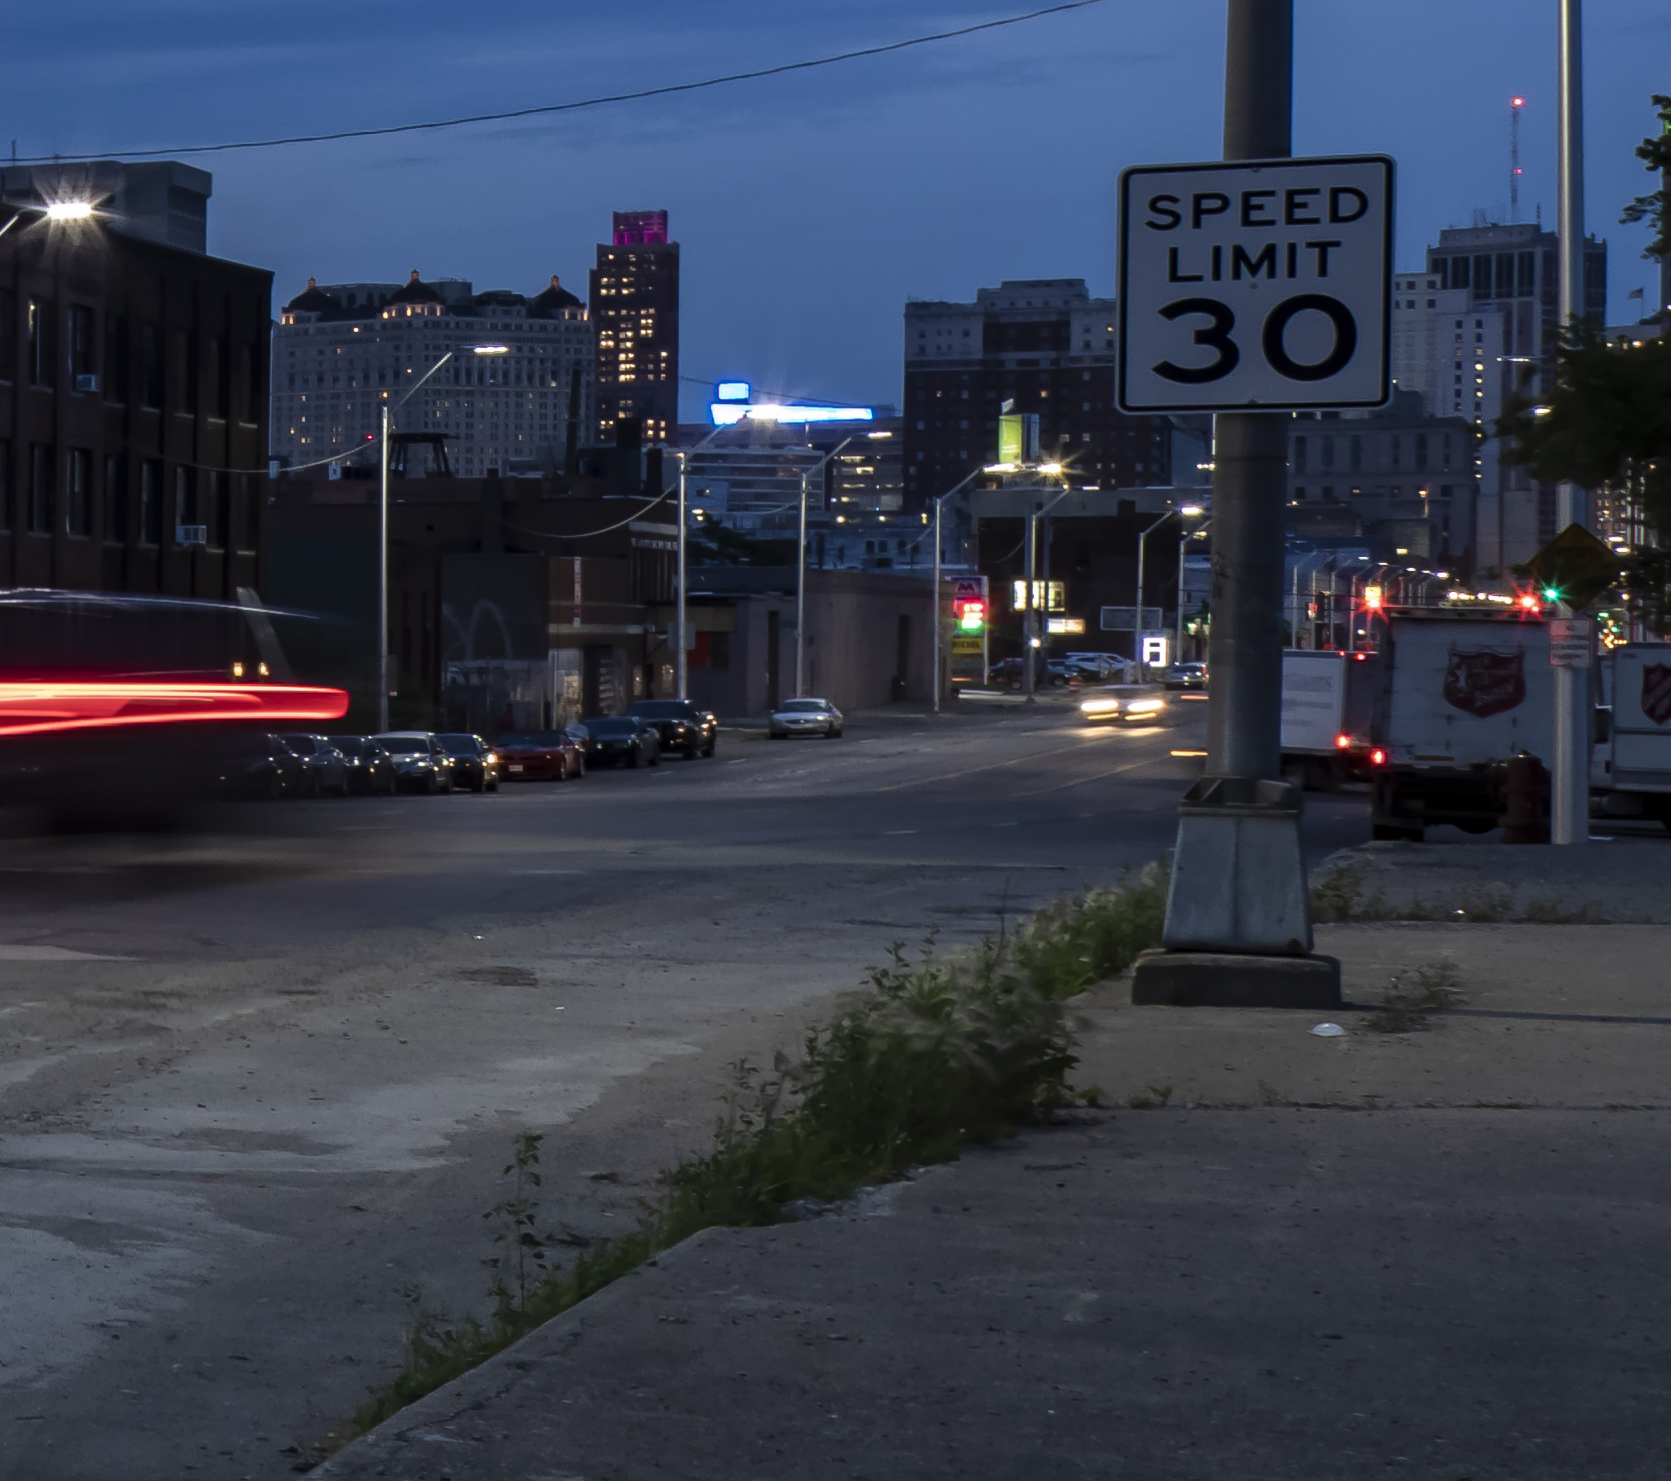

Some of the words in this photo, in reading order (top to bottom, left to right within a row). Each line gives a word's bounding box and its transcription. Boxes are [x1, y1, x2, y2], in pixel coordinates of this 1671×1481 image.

[1144, 186, 1369, 231] SPEED
[1168, 240, 1342, 283] LIMIT
[1150, 293, 1358, 384] 30
